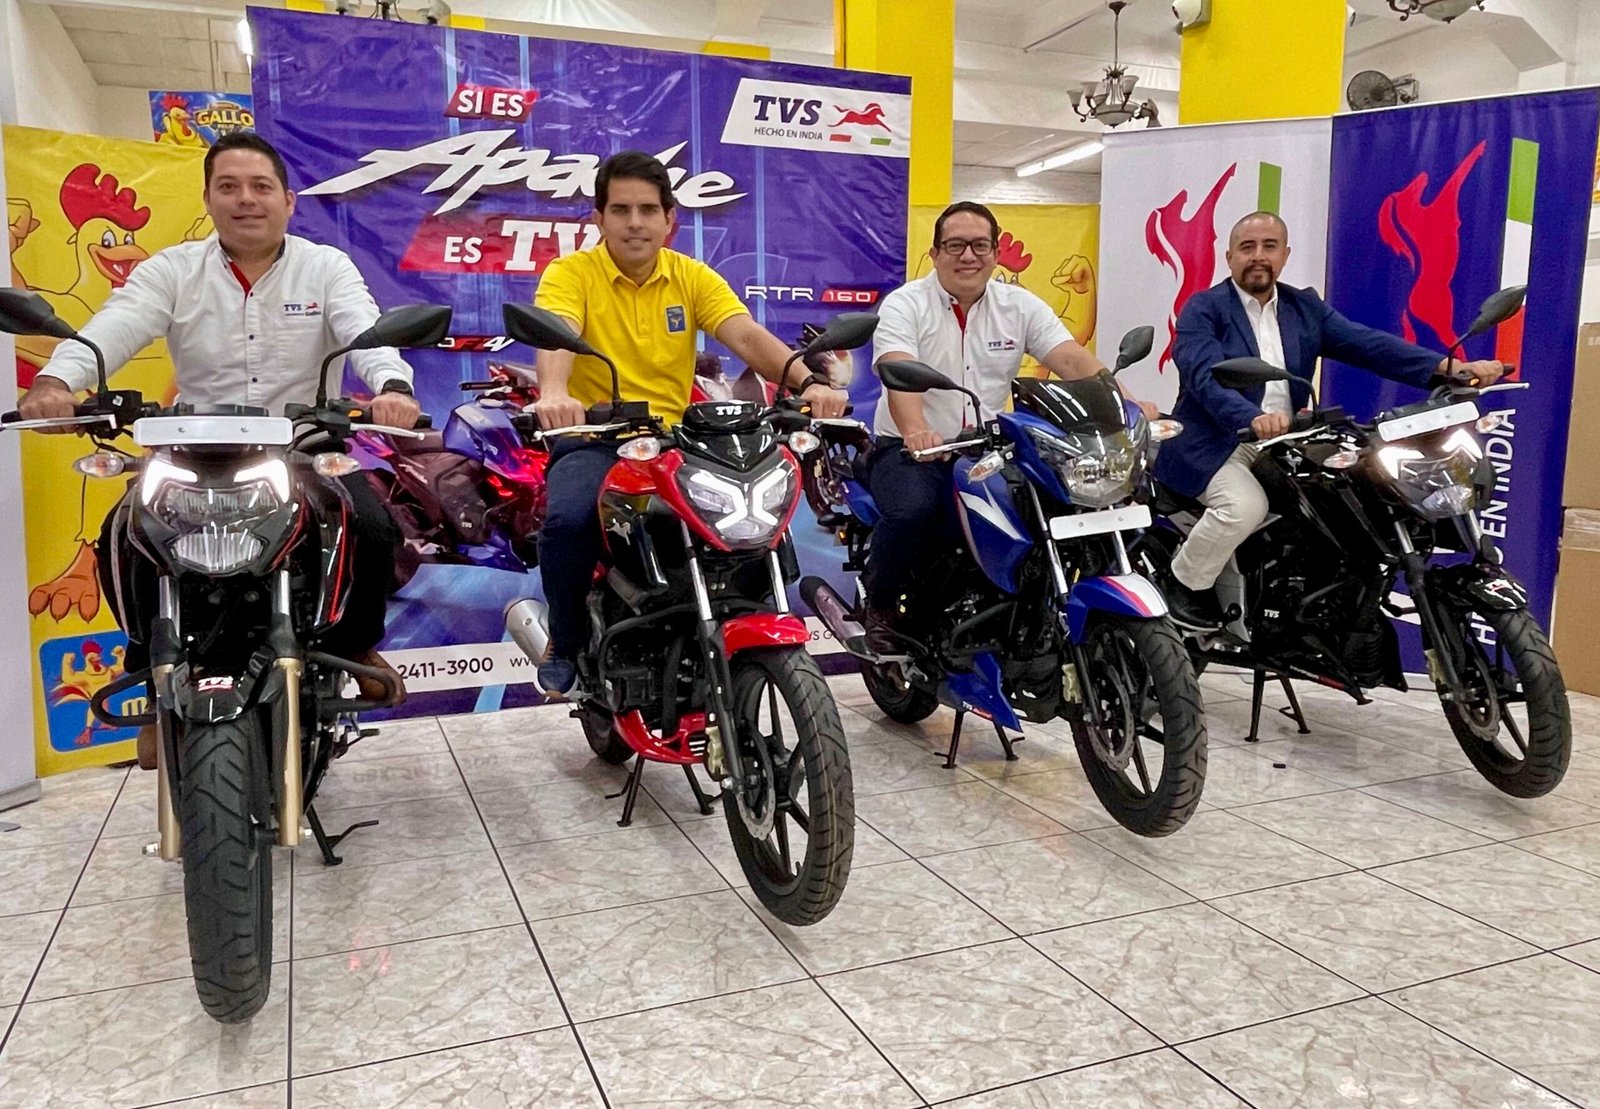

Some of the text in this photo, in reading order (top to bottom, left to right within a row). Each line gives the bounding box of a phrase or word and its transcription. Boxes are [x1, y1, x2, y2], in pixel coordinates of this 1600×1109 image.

[457, 89, 524, 117] SI ES
[753, 94, 823, 126] TVS
[196, 110, 254, 127] GALLO
[754, 127, 823, 140] HECHO EN INDIA
[298, 129, 749, 217] Apae
[443, 220, 601, 271] ES TV
[745, 286, 872, 303] RTR 160
[715, 405, 742, 416] TVS
[1264, 608, 1280, 619] TVS
[397, 657, 494, 680] 2411-3900
[198, 675, 234, 688] TVS
